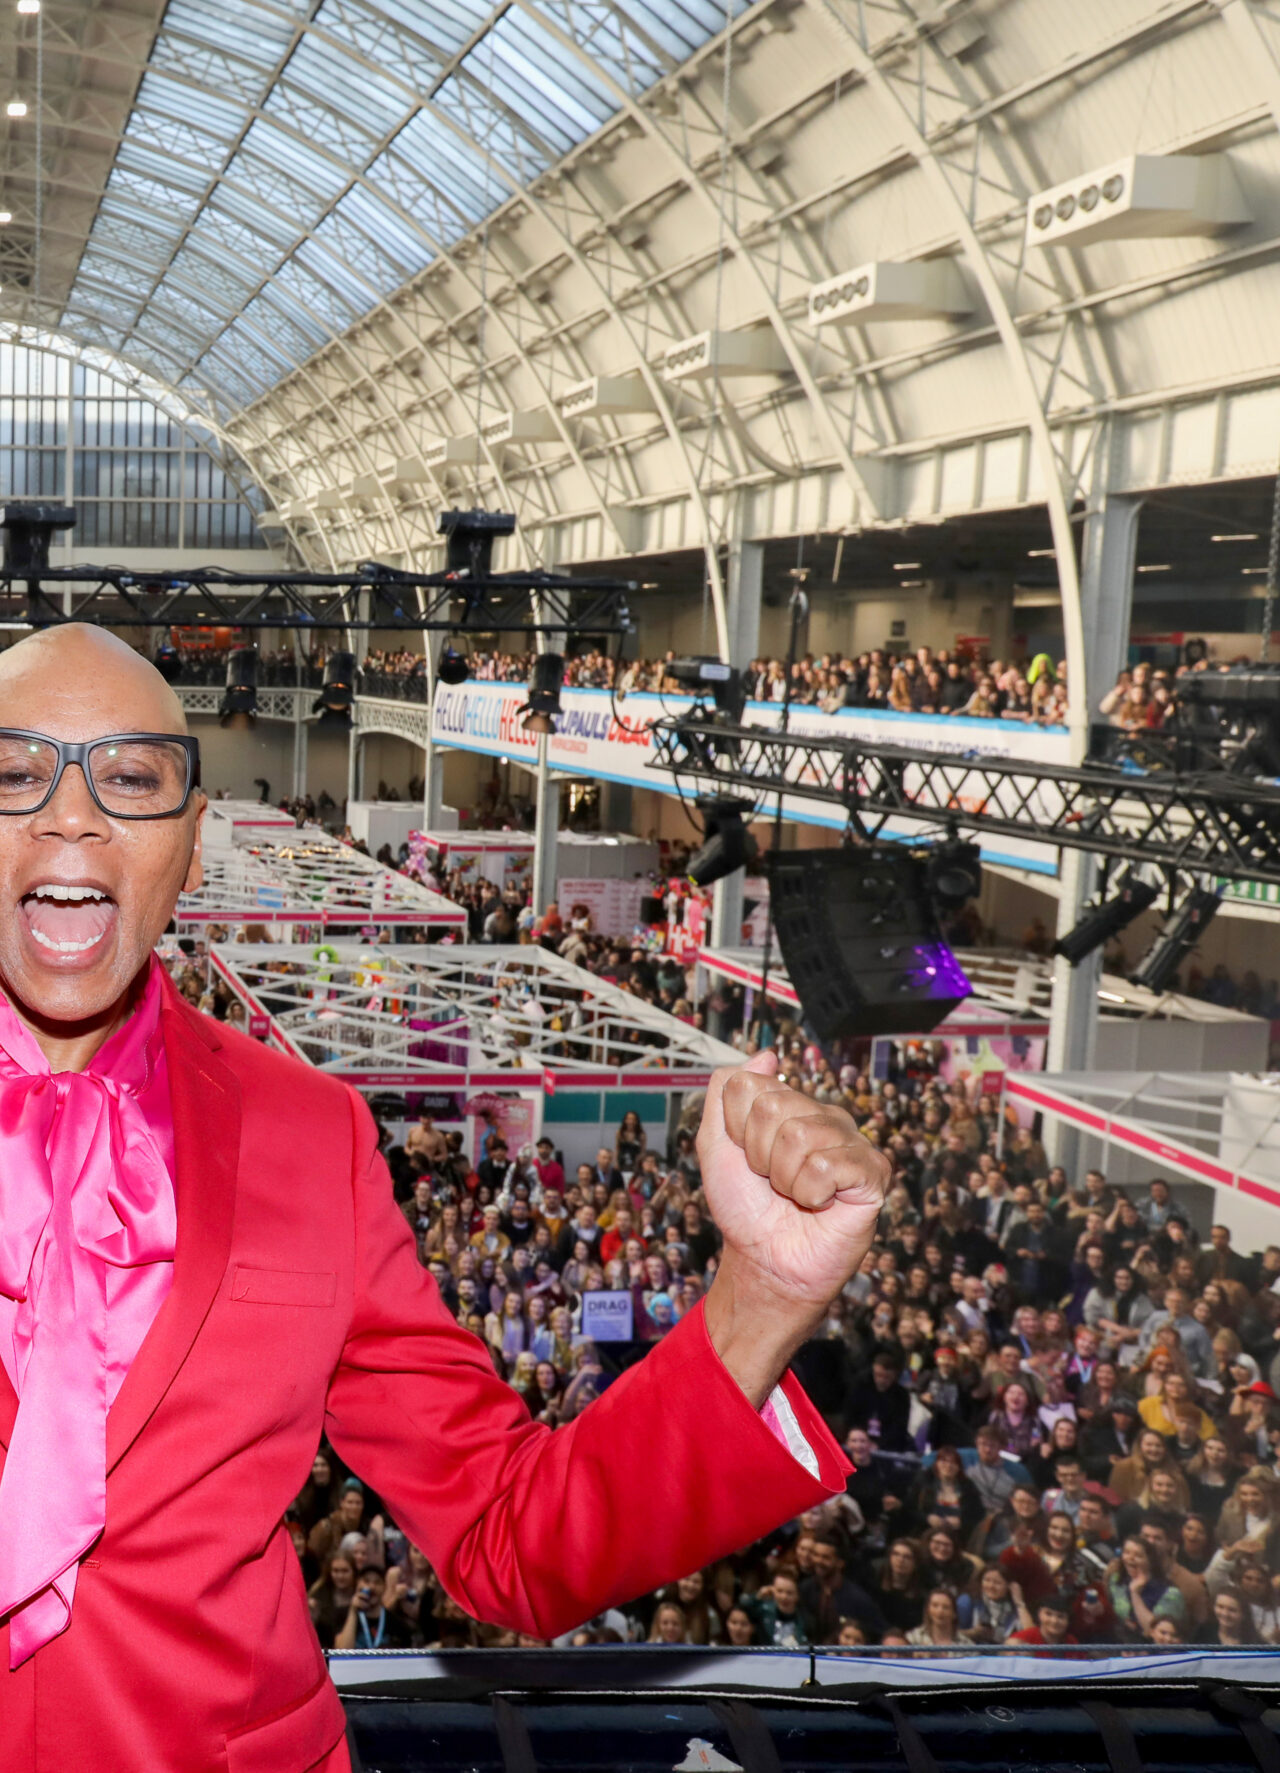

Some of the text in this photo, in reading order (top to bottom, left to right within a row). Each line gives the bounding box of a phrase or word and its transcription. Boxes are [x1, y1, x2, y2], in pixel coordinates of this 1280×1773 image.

[435, 692, 468, 733] HELLO
[465, 695, 502, 739] HELLO
[608, 714, 654, 747] DRAG
[588, 1300, 628, 1312] DRAG
